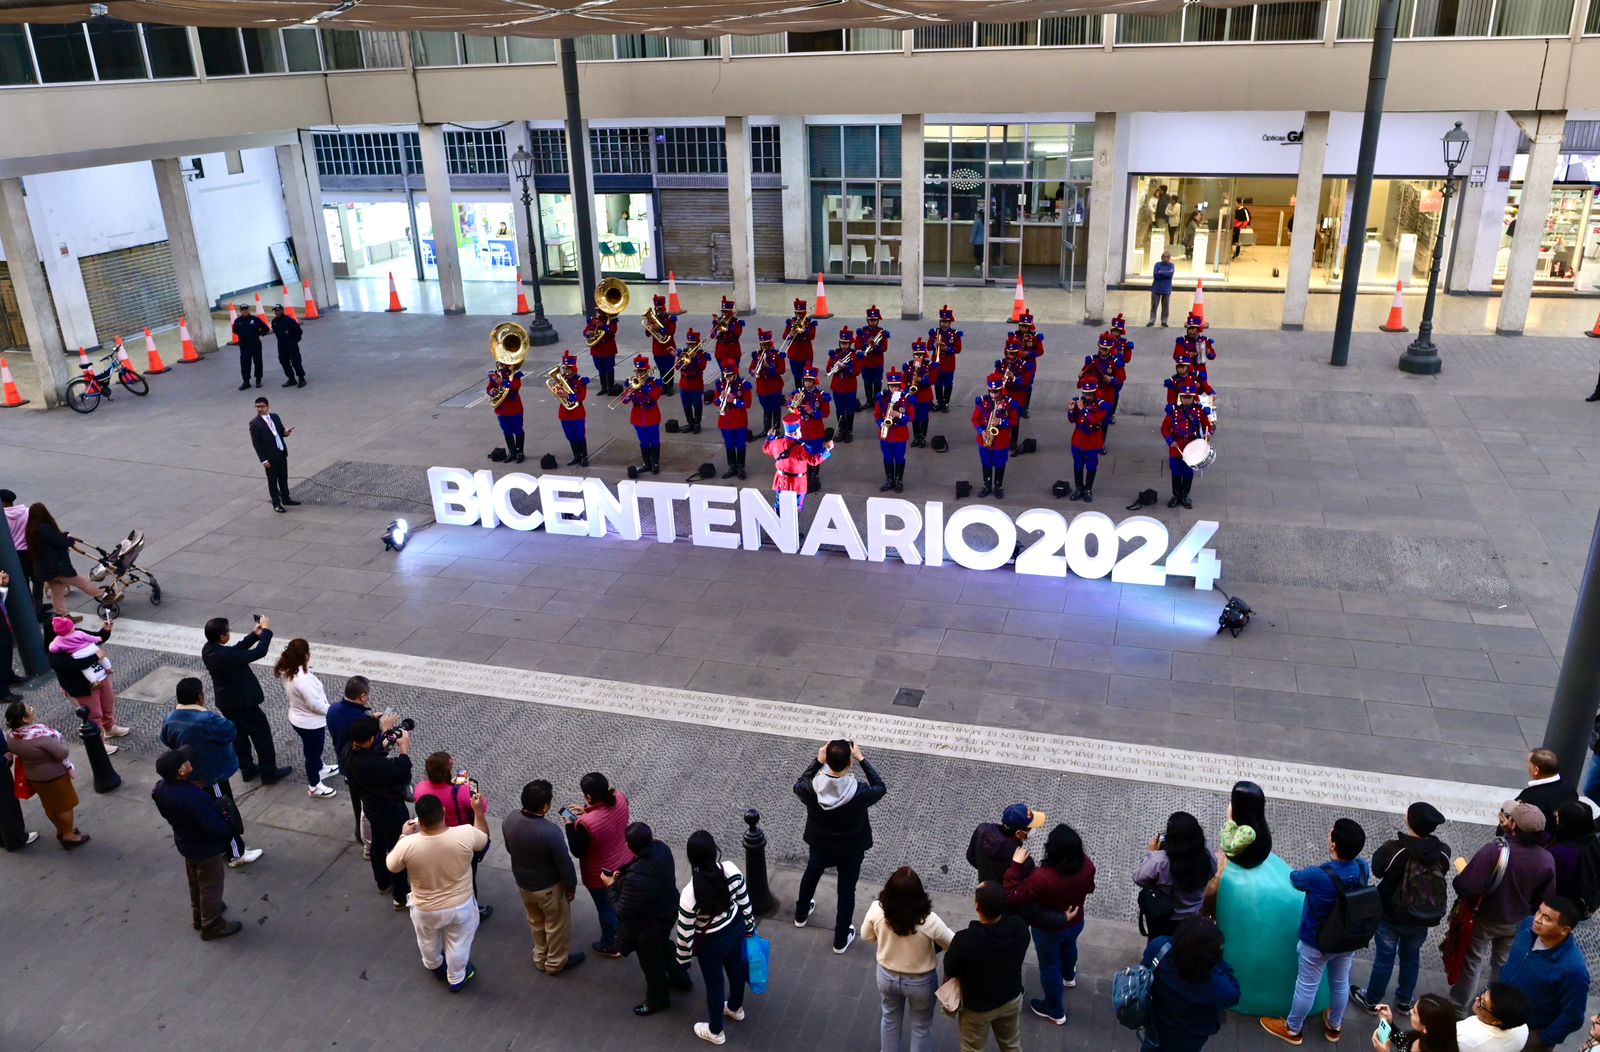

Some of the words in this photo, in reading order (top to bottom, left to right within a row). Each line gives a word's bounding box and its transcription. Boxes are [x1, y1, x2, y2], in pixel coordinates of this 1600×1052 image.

[728, 707, 751, 715] ERA
[751, 710, 800, 722] NUESTRA
[750, 719, 792, 730] HONOR
[936, 724, 982, 735] MARCO
[854, 732, 894, 743] MARZO
[895, 737, 911, 745] DE
[953, 735, 1010, 748] PLAZUELA
[1016, 733, 1046, 743] LIMA
[1014, 742, 1040, 752] ESTA
[1064, 739, 1114, 751] CIUDAD
[1117, 745, 1132, 753] LA
[994, 750, 1018, 759] SAN
[1021, 753, 1036, 761] DE
[1134, 747, 1165, 757] PARA
[1042, 756, 1138, 774] PROTECTORADO
[1115, 755, 1194, 771] DESEMBARCO
[1169, 752, 1252, 768] RECUPERADA
[1146, 768, 1158, 777] EL
[1197, 765, 1220, 774] DEL
[1163, 770, 1186, 780] POR
[1226, 768, 1312, 785] ANIVERSARIO
